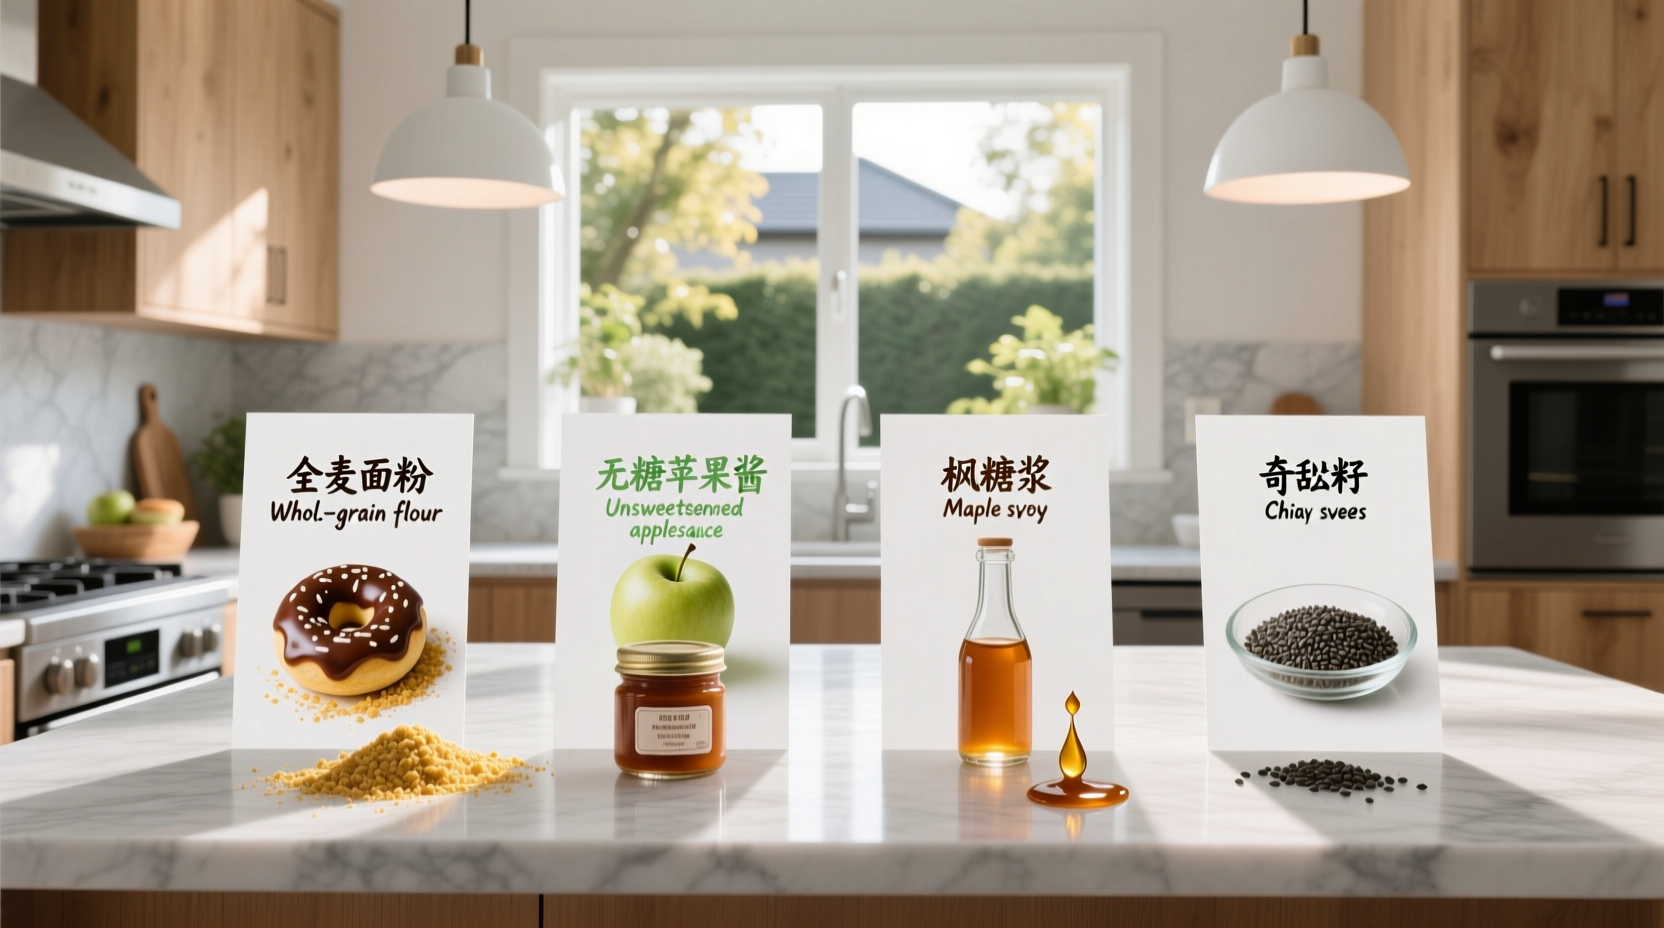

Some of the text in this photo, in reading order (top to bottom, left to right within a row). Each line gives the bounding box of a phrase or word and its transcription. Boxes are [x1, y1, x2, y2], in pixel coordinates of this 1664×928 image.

[287, 454, 435, 495] 全麦面粉
[595, 453, 768, 495] 无糖苹果酱
[941, 454, 1053, 495] 枫糖浆
[392, 499, 444, 529] flour
[942, 496, 1002, 526] Maple
[1264, 499, 1367, 525] Chiay svees
